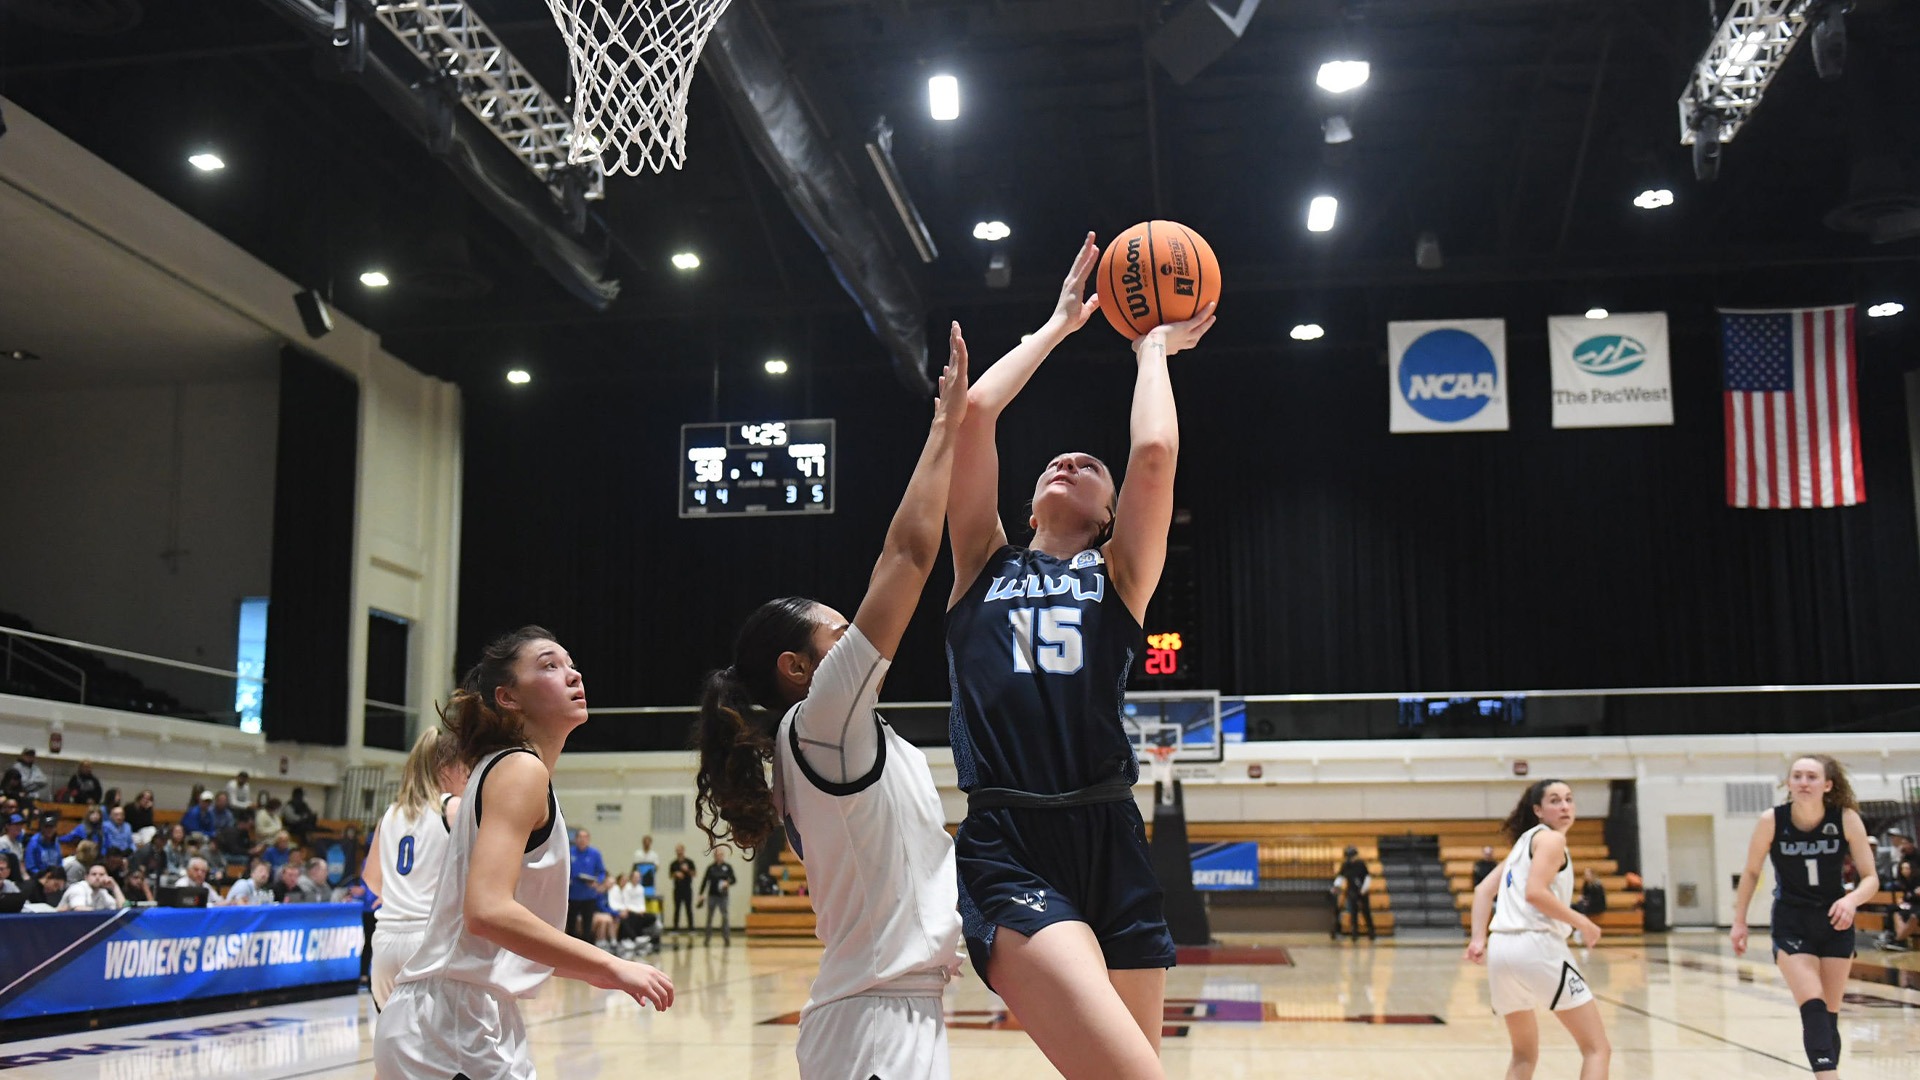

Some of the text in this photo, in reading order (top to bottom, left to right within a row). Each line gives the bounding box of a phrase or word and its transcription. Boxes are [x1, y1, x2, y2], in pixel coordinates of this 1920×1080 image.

[1122, 236, 1150, 319] Wilson
[1408, 373, 1495, 401] NCAA
[1553, 387, 1668, 405] The PacWest
[741, 422, 787, 446] 4:25
[751, 461, 764, 477] 4
[797, 456, 825, 477] 47
[694, 489, 707, 505] 4
[716, 488, 729, 504] 4
[786, 485, 798, 503] 3
[811, 484, 824, 502] 5
[984, 573, 1104, 603] WWU
[1008, 605, 1084, 675] 15
[1145, 648, 1177, 674] 20
[396, 835, 415, 876] 0
[1779, 839, 1840, 856] WWU
[1804, 858, 1819, 887] 1
[104, 936, 201, 980] WOMEN'S
[201, 929, 304, 973] BASKETBALL
